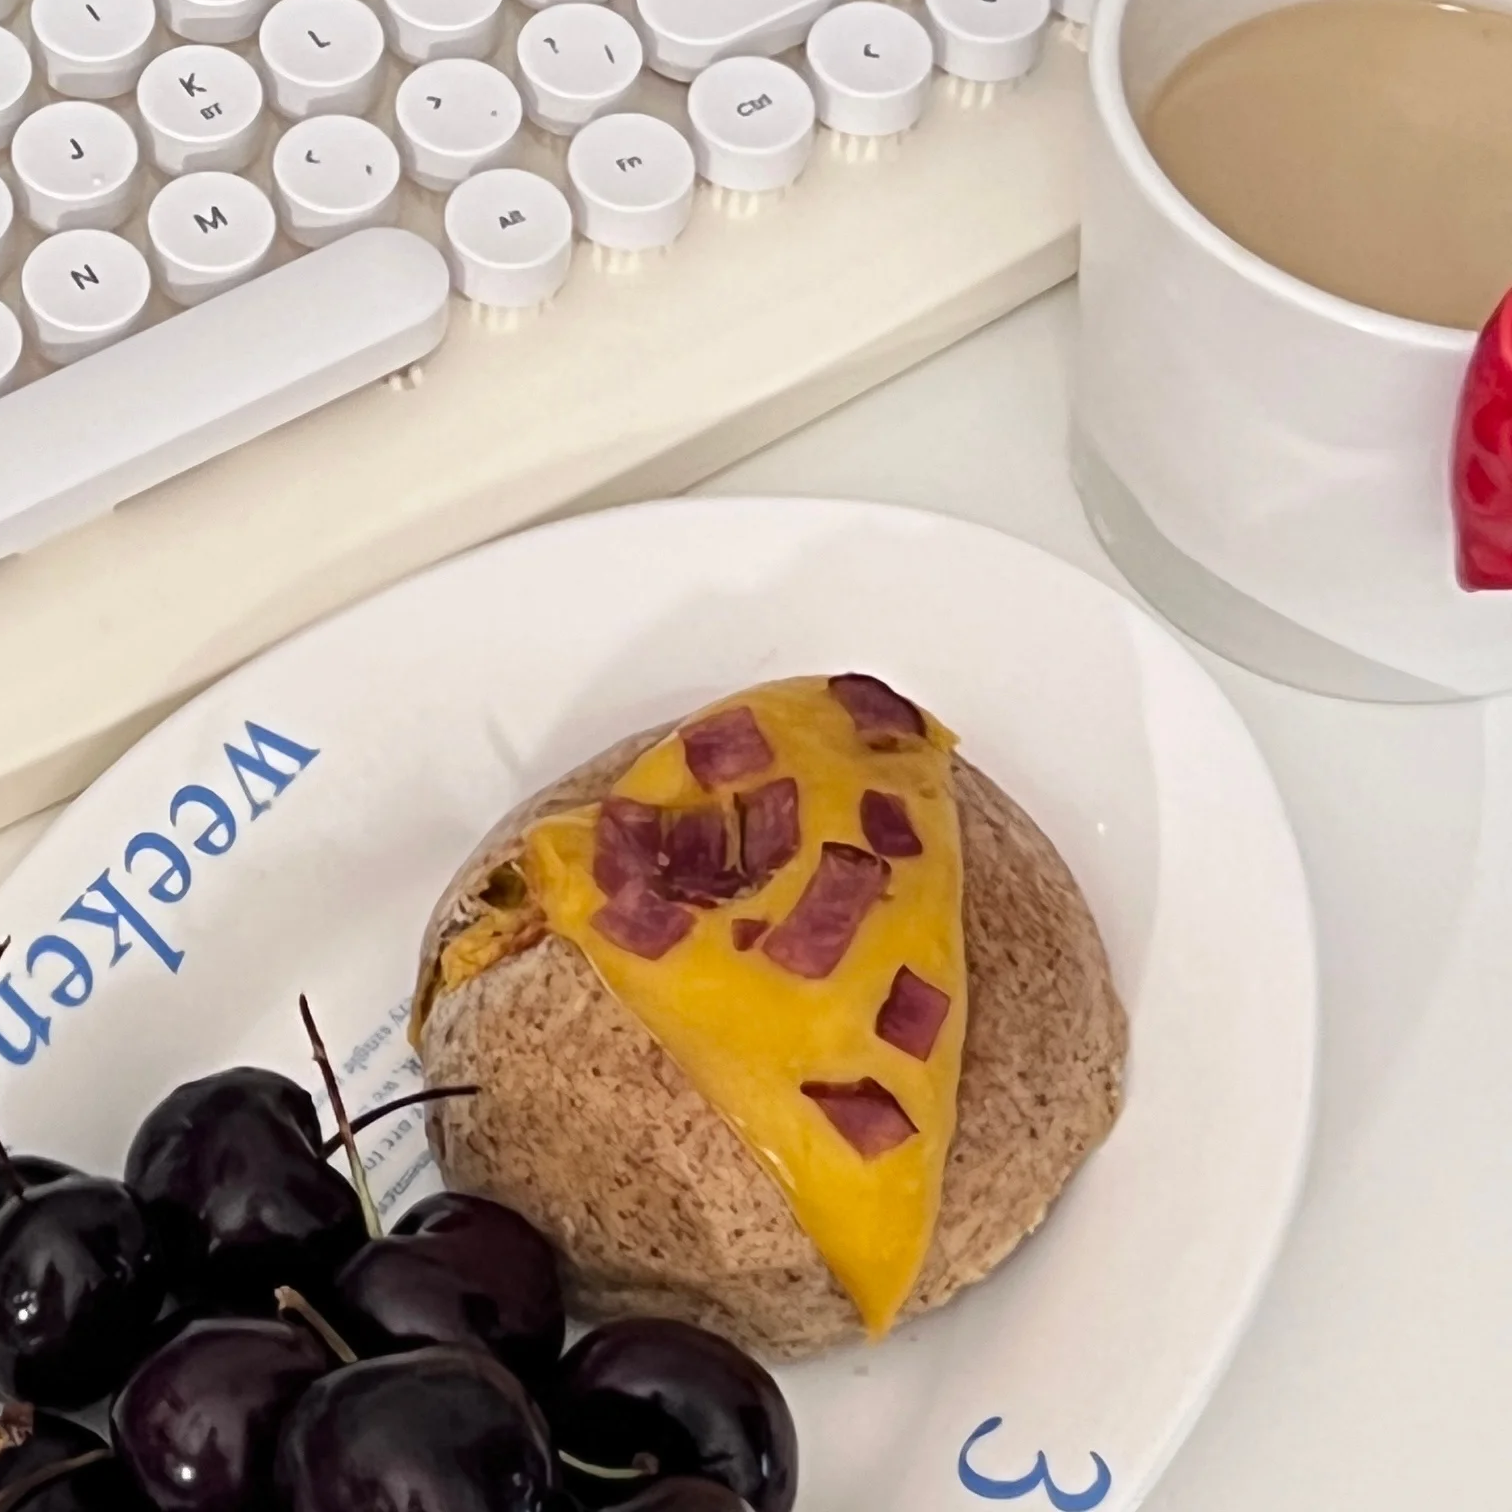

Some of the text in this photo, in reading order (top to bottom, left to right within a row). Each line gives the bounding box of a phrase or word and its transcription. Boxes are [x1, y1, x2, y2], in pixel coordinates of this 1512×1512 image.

[307, 30, 332, 48] L
[178, 73, 208, 98] K
[69, 138, 85, 160] J
[193, 205, 229, 234] M
[70, 263, 100, 290] N
